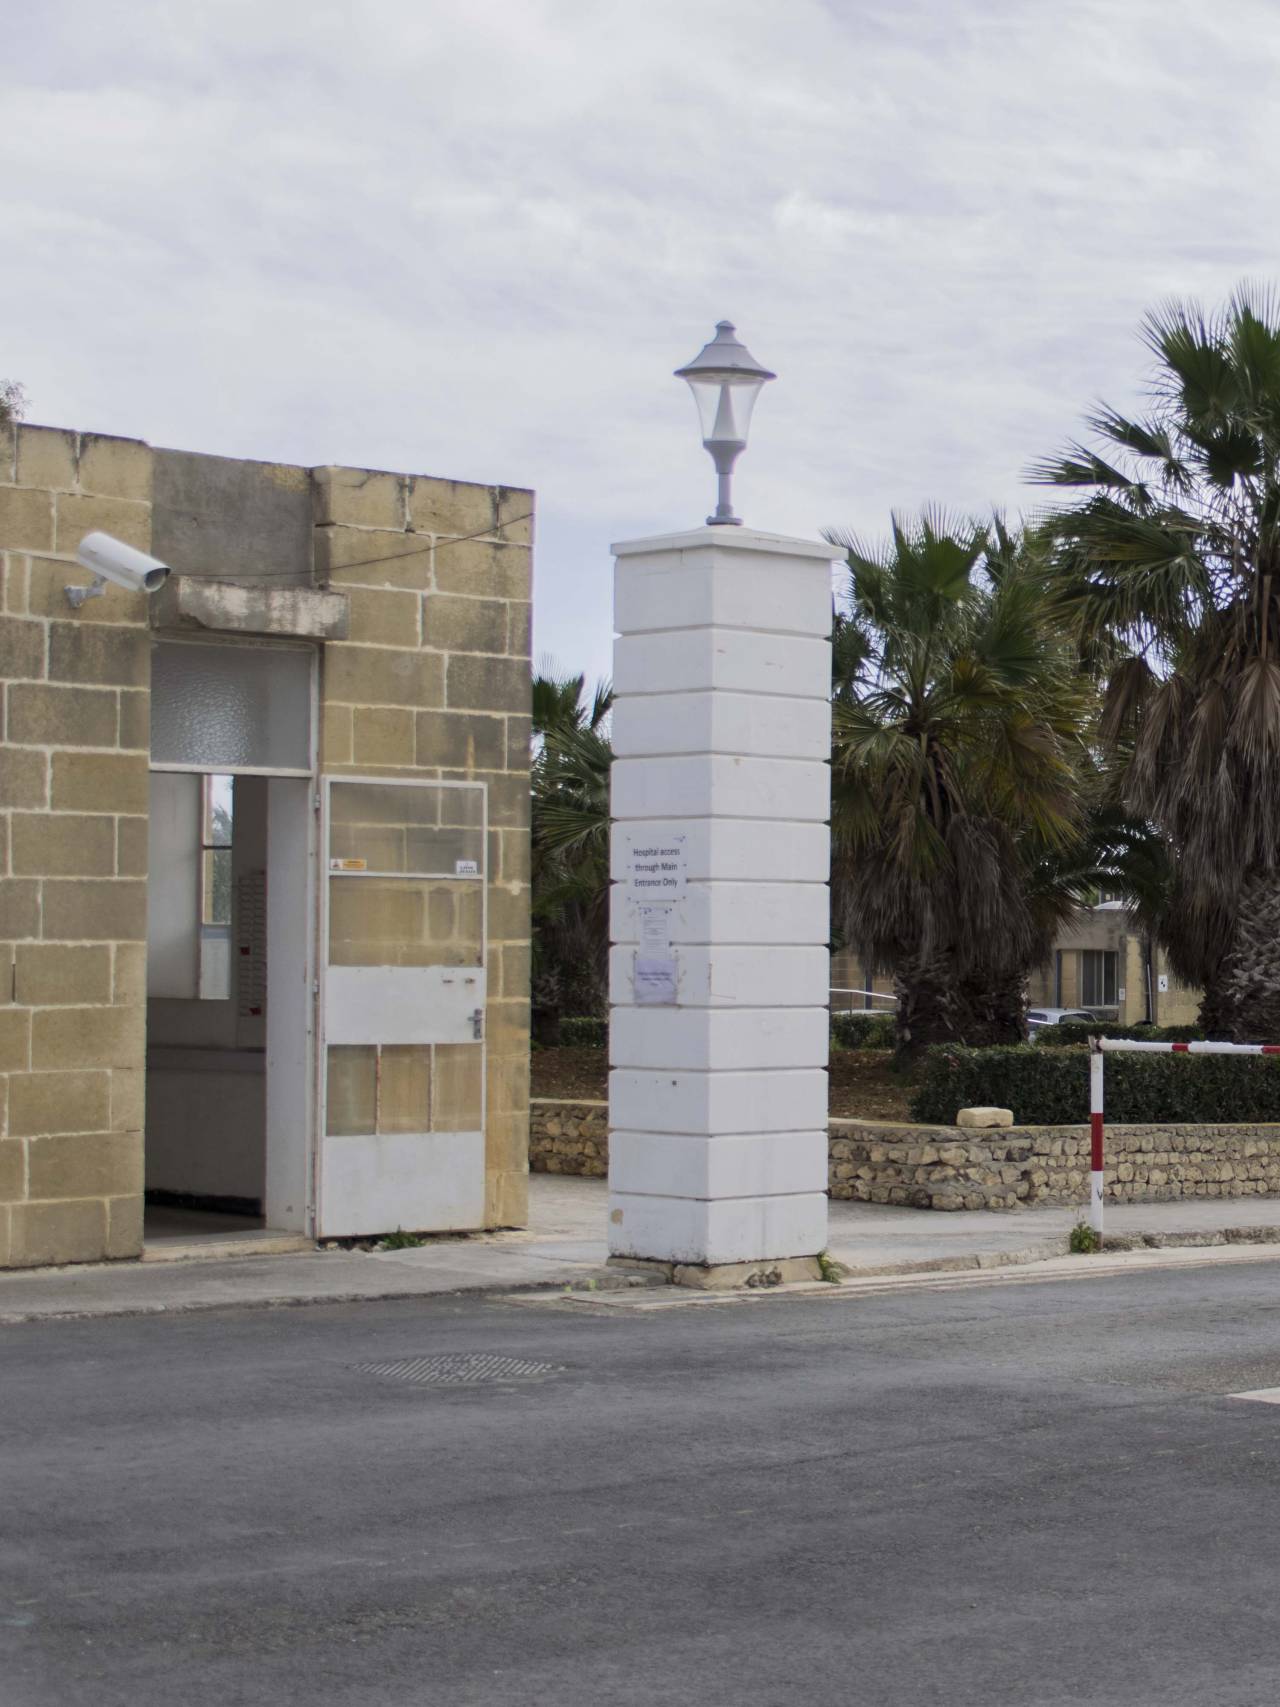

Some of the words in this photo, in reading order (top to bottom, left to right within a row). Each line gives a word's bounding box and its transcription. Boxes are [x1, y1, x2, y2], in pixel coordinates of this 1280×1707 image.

[633, 848, 659, 858] Hospital
[660, 848, 680, 856] access
[634, 863, 660, 873] through
[661, 863, 678, 871] Main
[634, 878, 661, 887] Entrance
[662, 878, 678, 888] Only
